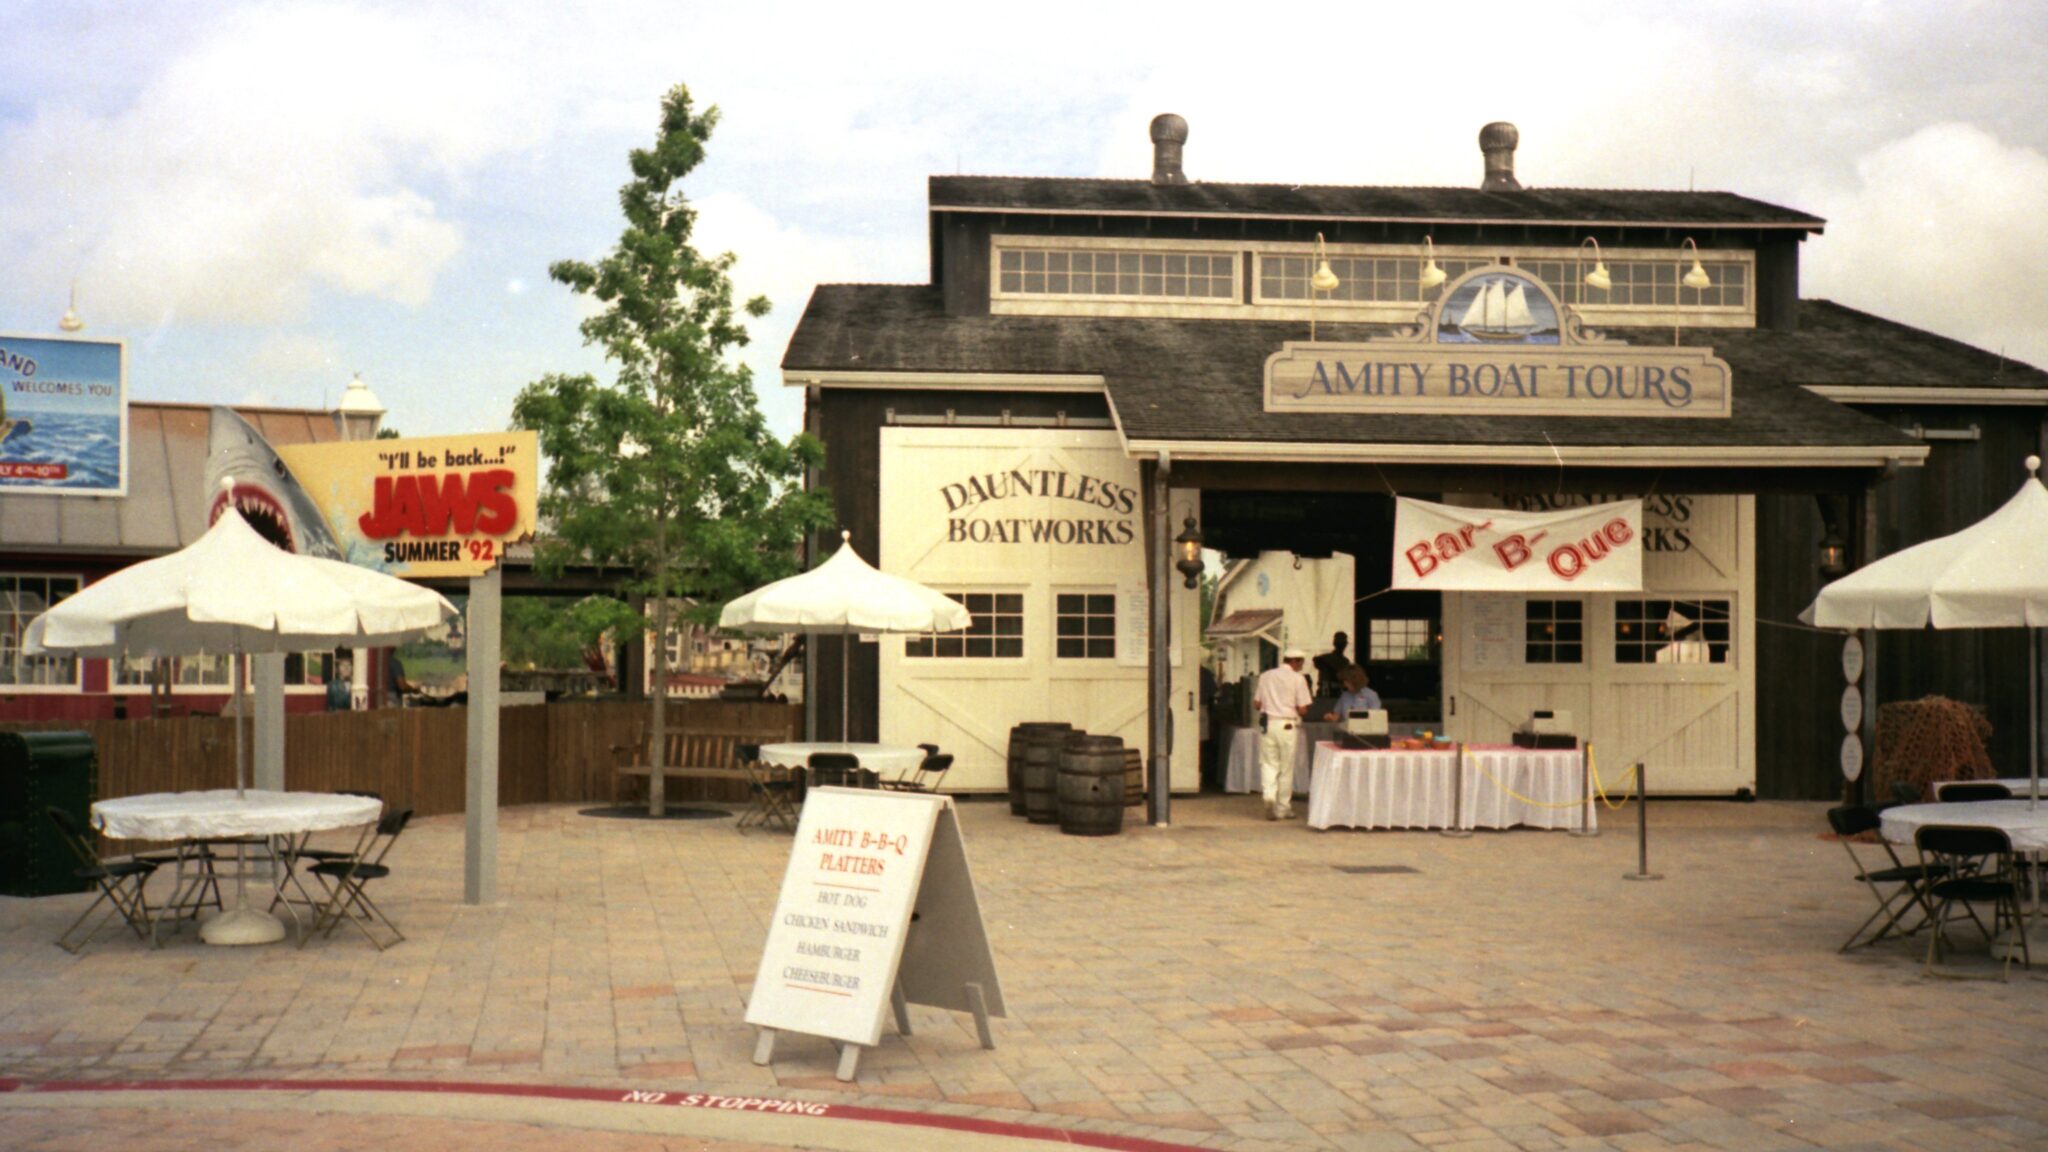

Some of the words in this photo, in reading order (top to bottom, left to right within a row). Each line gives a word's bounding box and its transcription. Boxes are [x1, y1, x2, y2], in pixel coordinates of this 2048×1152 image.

[12, 381, 83, 396] WELCOMES
[88, 384, 112, 396] YOU
[1293, 359, 1432, 399] AMITY
[1448, 362, 1548, 399] BOAT
[1556, 363, 1693, 408] TOURS
[417, 451, 437, 468] be
[357, 468, 518, 541] JAWS
[940, 469, 1137, 515] DAUNTLESS
[948, 518, 1135, 545] BOATWORKS
[384, 541, 461, 563] SUMMER
[463, 538, 494, 561] '92
[813, 828, 856, 847] AMITY
[860, 831, 908, 856] B-B-Q
[820, 853, 886, 875] PLATTERS
[817, 891, 840, 906] HOT
[843, 893, 868, 909] DOG
[784, 912, 830, 930] CHICKEN
[832, 919, 889, 938] SANDWICH
[796, 941, 861, 962] HAMBURGER
[783, 966, 861, 990] CHEESEBURGER
[620, 1090, 667, 1102] NO
[679, 1094, 830, 1115] STOPPING
